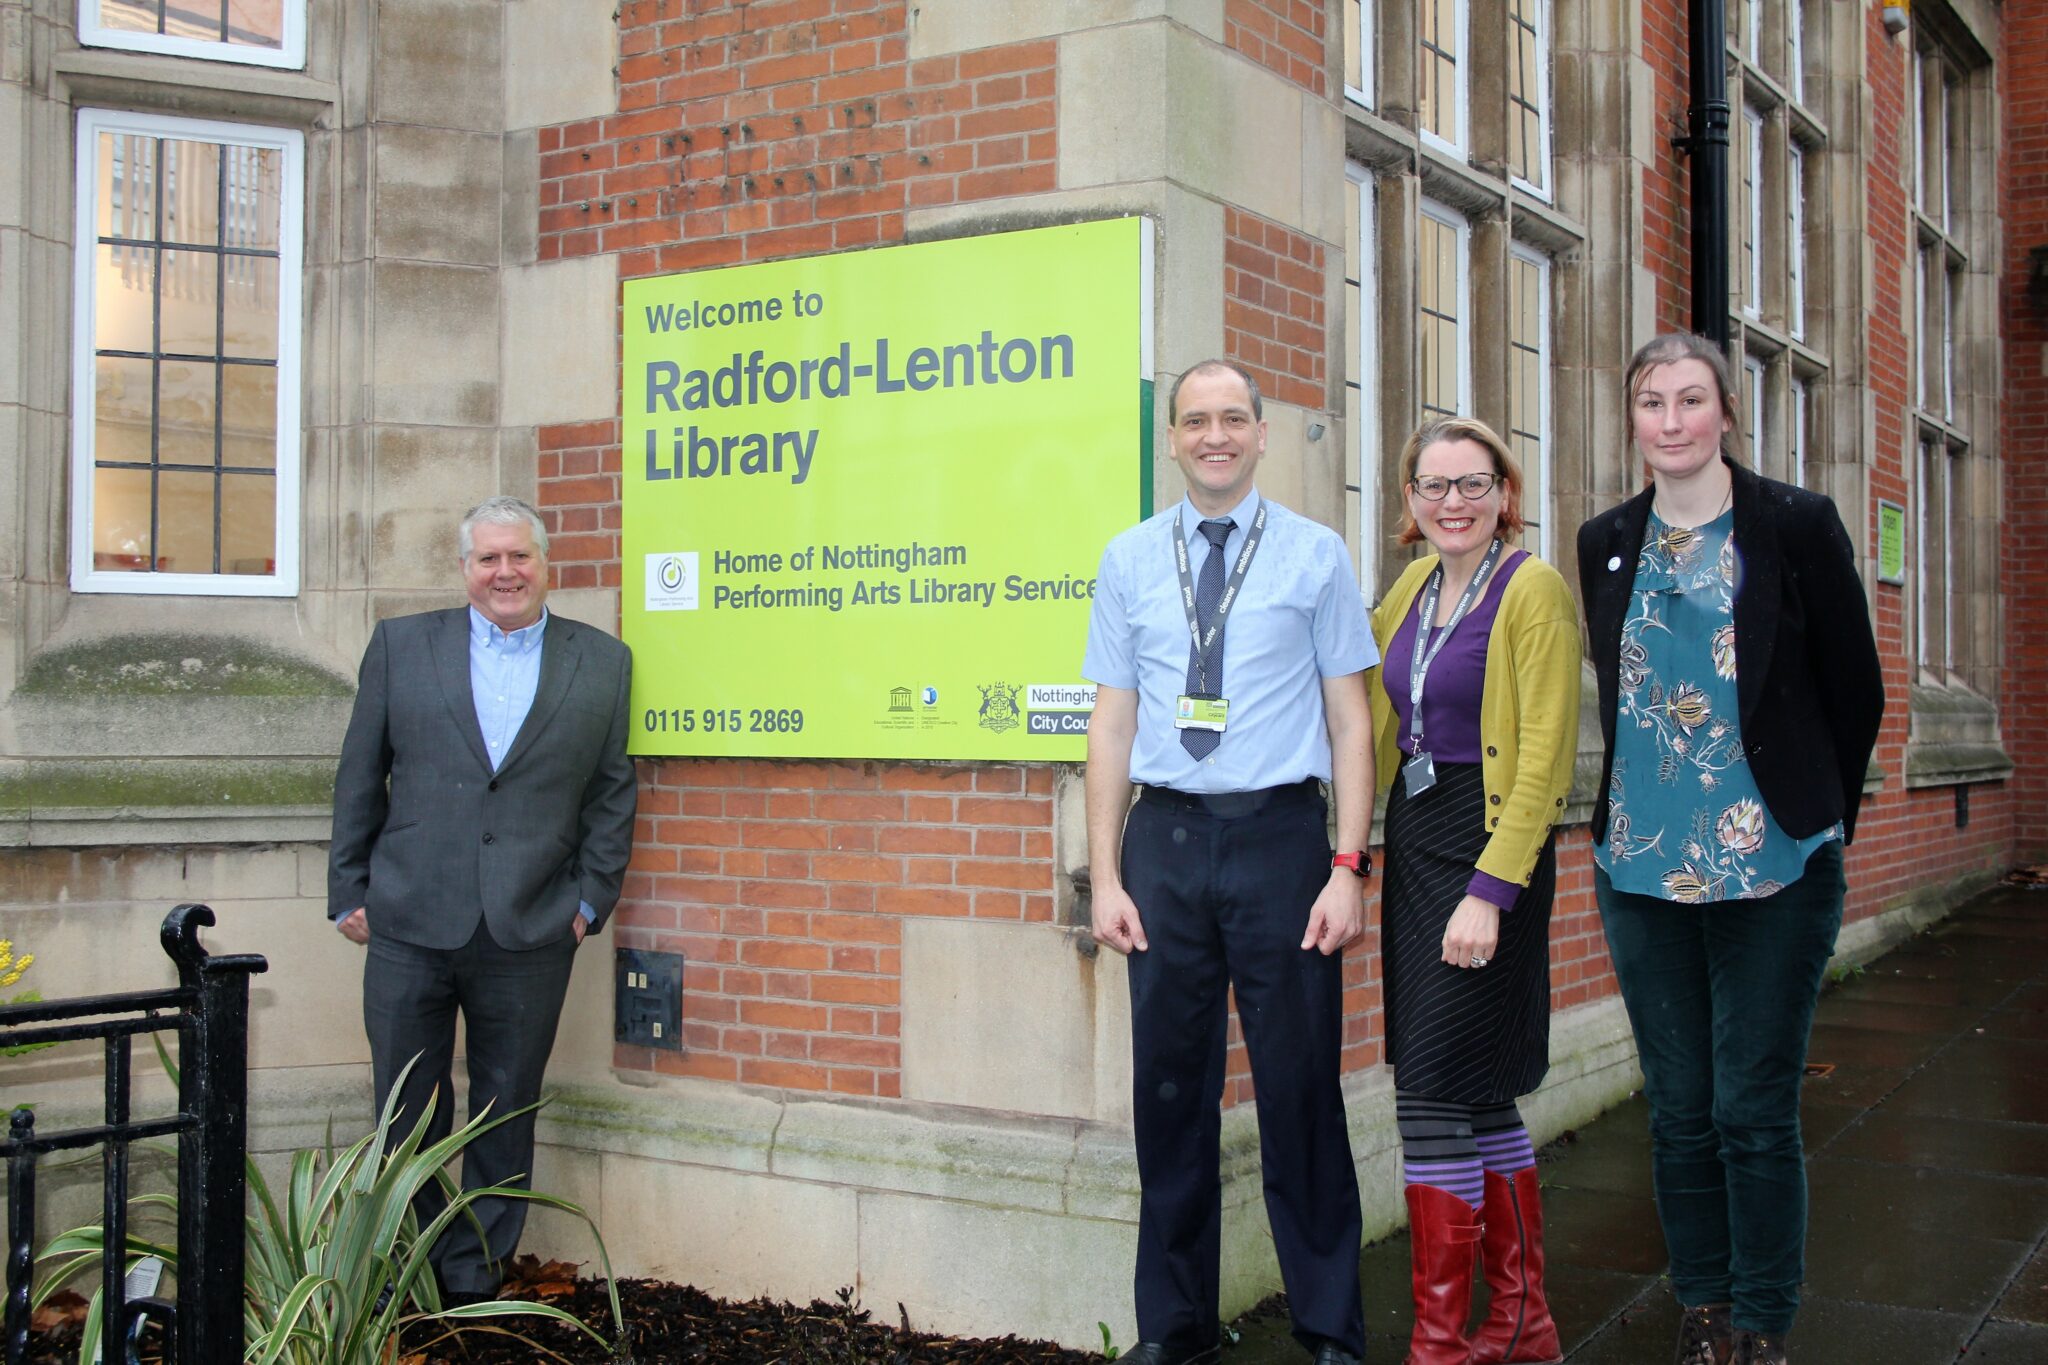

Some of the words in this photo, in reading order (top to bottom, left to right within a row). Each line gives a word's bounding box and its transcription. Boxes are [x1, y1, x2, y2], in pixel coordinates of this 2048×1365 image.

[645, 298, 783, 334] Welcome
[792, 290, 823, 318] to
[646, 330, 1073, 413] Radford-Lenton
[645, 426, 819, 484] Library
[714, 551, 783, 574] Home
[790, 547, 815, 572] of
[822, 542, 966, 573] Nottingham
[1472, 560, 1490, 586] cleaner
[714, 583, 843, 612] Performing
[851, 580, 901, 605] Arts
[909, 577, 996, 609] Library
[1183, 586, 1193, 608] proud
[1204, 626, 1216, 647] safer
[1219, 586, 1236, 613] cleaner
[1236, 539, 1256, 574] ambitious
[1448, 593, 1471, 626] ambitious
[1422, 596, 1435, 630] ambitious
[1032, 688, 1097, 705] Nottingha
[644, 709, 696, 733] 0115
[702, 709, 742, 733] 915
[749, 709, 804, 733] 2869
[1031, 715, 1058, 732] City
